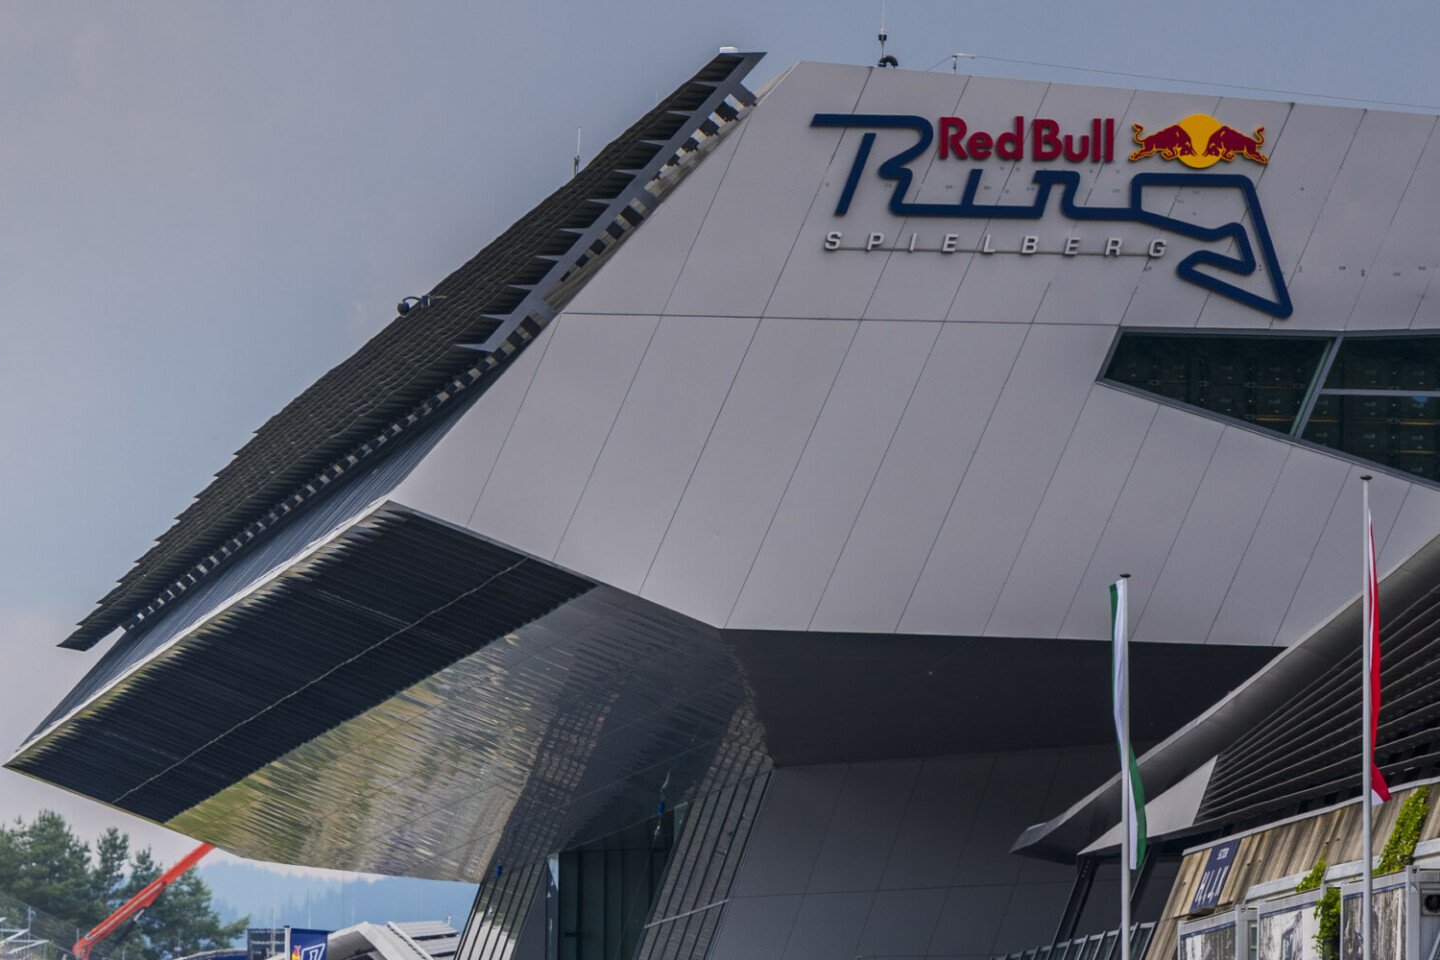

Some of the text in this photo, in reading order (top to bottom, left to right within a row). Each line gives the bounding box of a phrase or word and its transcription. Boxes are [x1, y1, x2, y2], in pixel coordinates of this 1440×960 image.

[938, 116, 1115, 162] Red Bull
[810, 113, 1293, 318] Ring
[824, 231, 1168, 258] SPIELBERG
